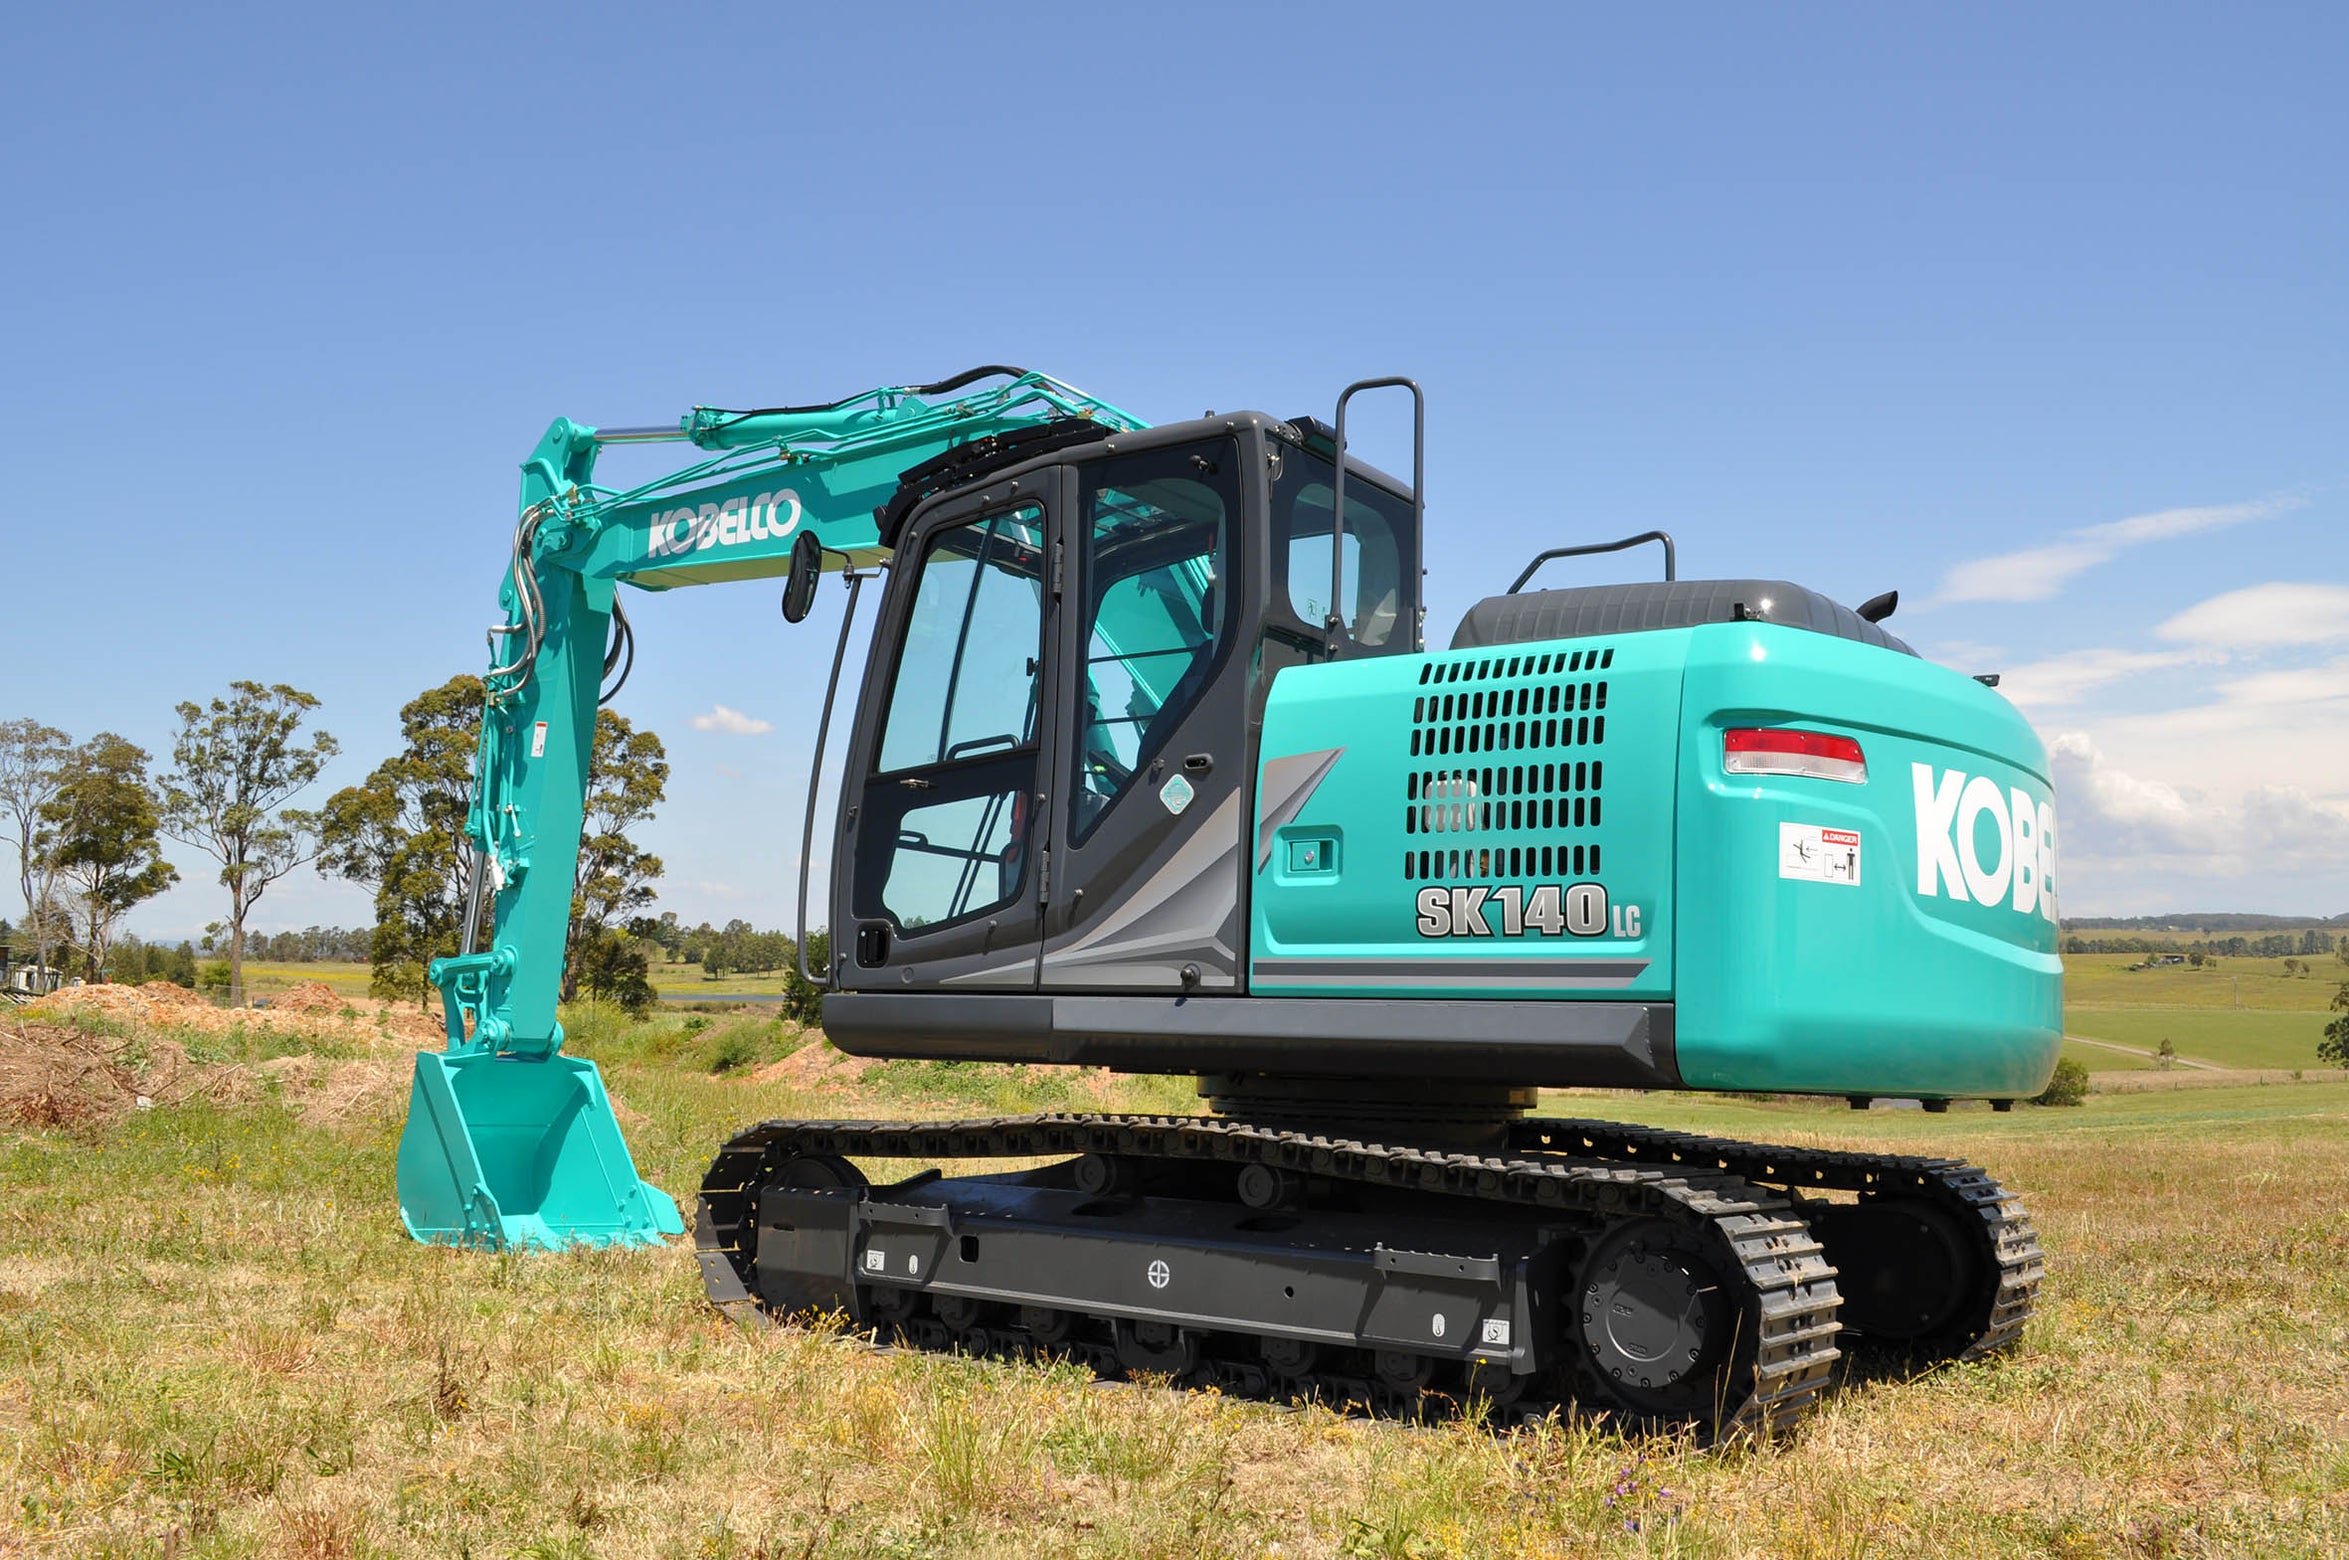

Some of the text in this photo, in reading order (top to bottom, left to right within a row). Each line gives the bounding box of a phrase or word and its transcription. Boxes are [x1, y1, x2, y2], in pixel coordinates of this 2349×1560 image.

[648, 488, 801, 558] KOBELCO
[1829, 832, 1858, 843] DANGER
[1911, 761, 2058, 925] KOBE
[1416, 882, 1641, 937] SK140 LC
